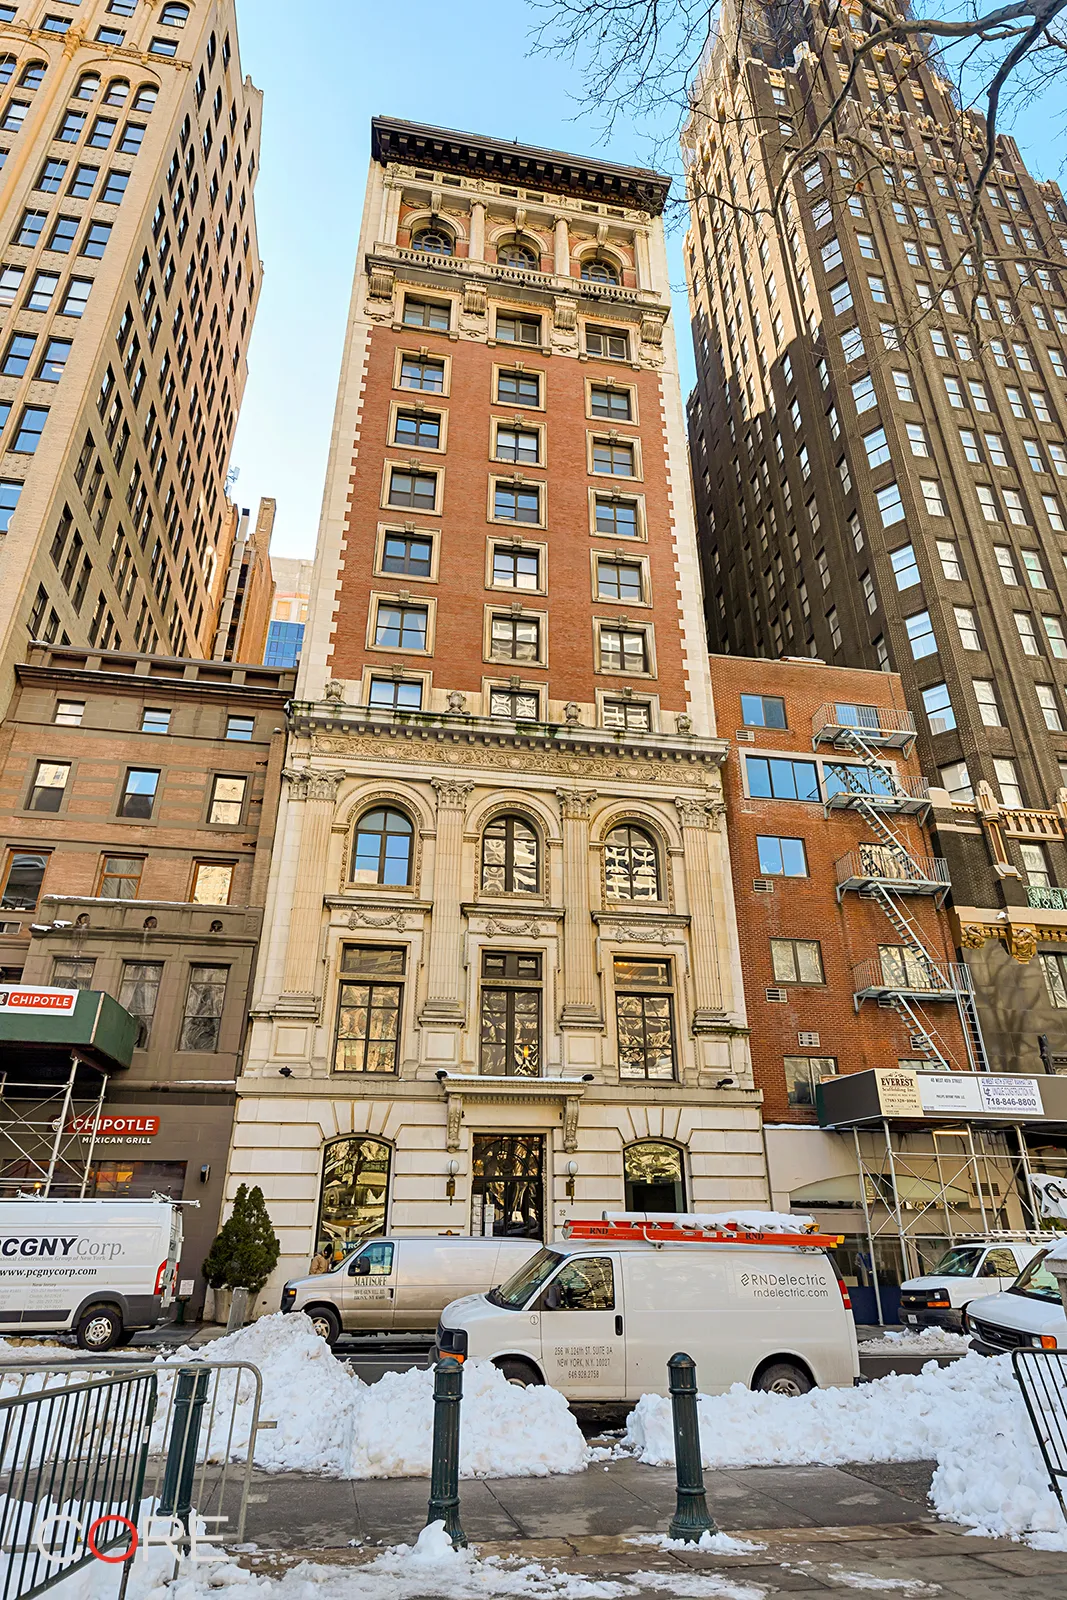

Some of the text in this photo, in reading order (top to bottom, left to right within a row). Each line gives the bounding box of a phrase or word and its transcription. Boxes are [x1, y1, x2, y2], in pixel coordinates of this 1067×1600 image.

[11, 995, 71, 1007] CHIPOTLE
[881, 1077, 914, 1087] EVEREST
[986, 1098, 1037, 1107] 718-846-8800
[73, 1118, 155, 1131] CHIPOTLE
[559, 1209, 566, 1217] 32
[589, 1227, 608, 1235] RND
[745, 1232, 764, 1240] RND
[0, 1238, 126, 1260] CGNY Corp.
[0, 1267, 97, 1278] www.pcgnycorp.com
[751, 1273, 827, 1286] RNDelectric
[753, 1287, 829, 1298] rndelectric.com
[554, 1346, 564, 1356] 256
[592, 1345, 605, 1355] SUITE
[606, 1346, 613, 1355] 3A
[556, 1358, 568, 1367] NEW
[596, 1358, 610, 1367] 10027
